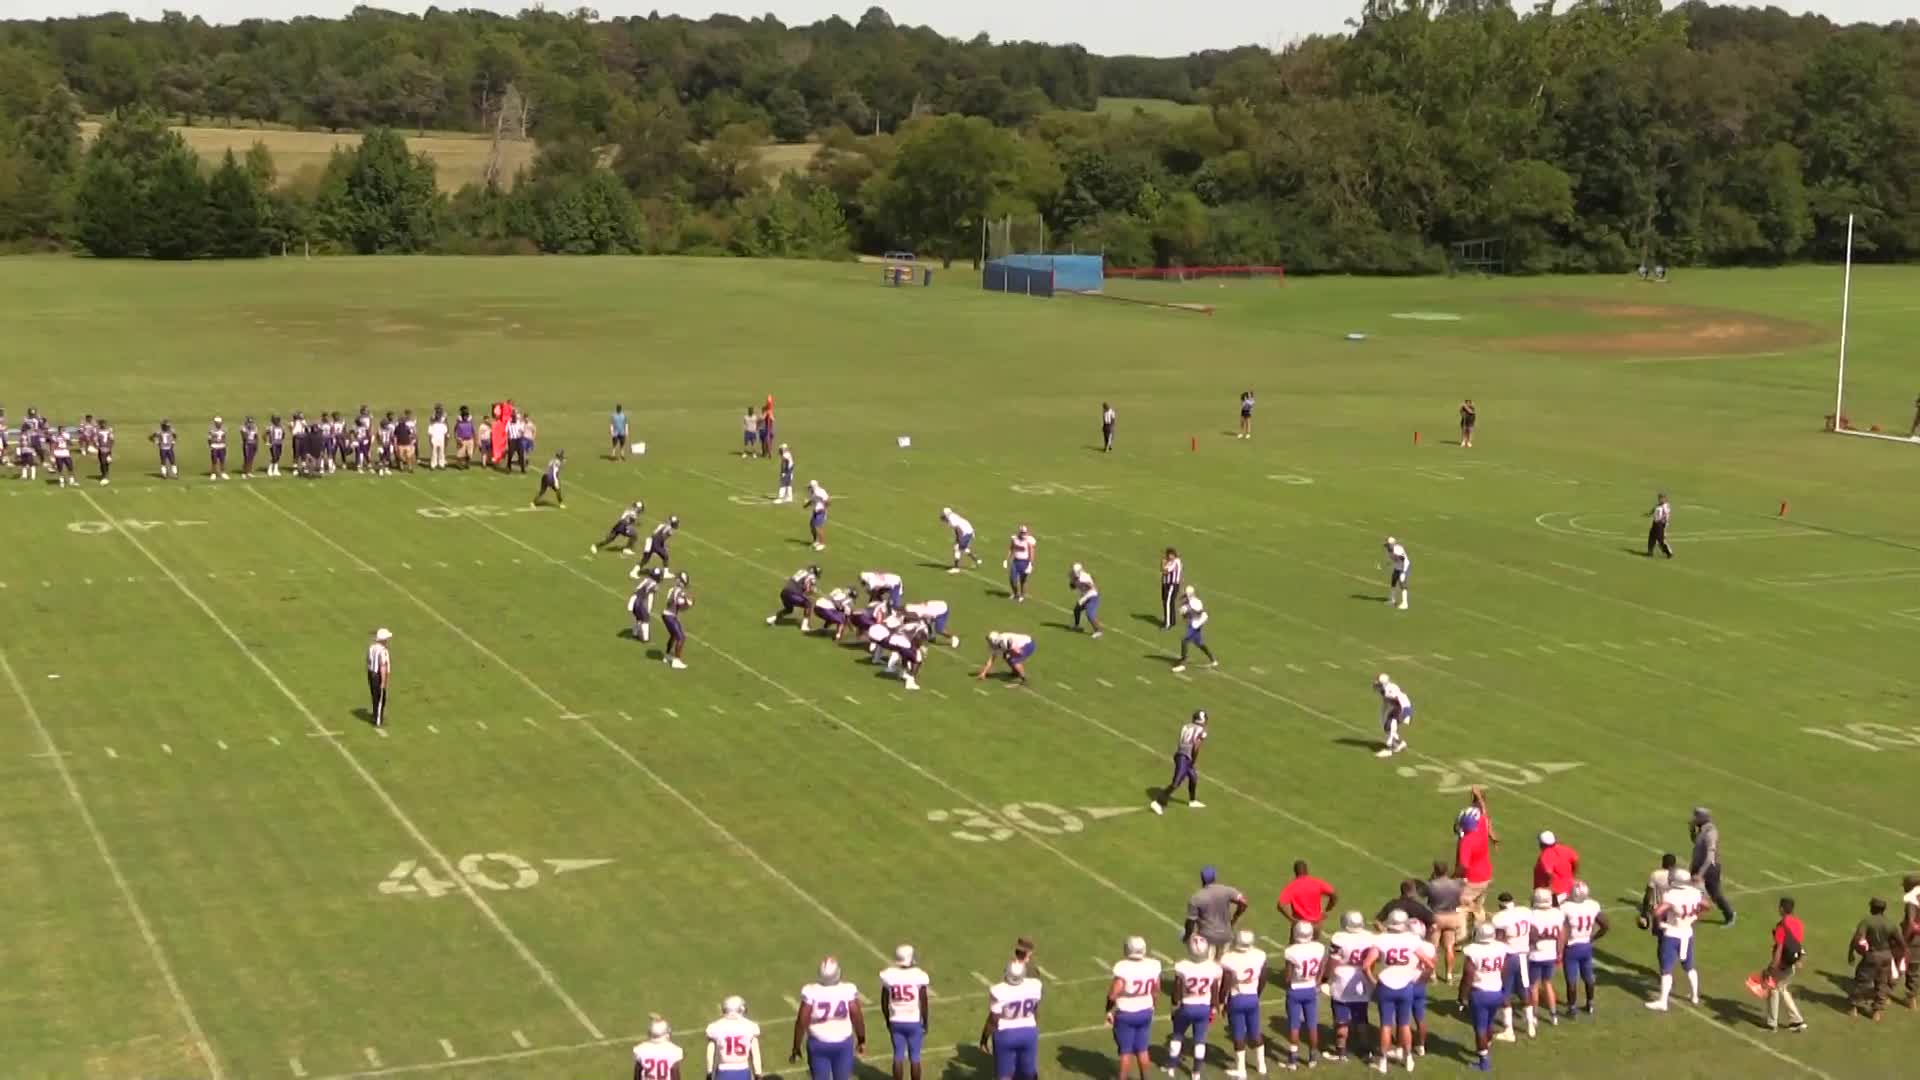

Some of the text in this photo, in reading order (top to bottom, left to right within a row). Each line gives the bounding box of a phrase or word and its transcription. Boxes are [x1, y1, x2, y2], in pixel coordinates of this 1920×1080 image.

[1396, 758, 1543, 793] 20
[927, 801, 1084, 842] 30
[377, 853, 540, 898] 40
[1577, 915, 1592, 932] 11
[1386, 948, 1410, 966] 65
[1302, 958, 1320, 978] 12
[891, 983, 915, 1002] 85
[1186, 977, 1210, 995] 22
[816, 1000, 849, 1022] 74
[724, 1035, 747, 1056] 15
[643, 1058, 670, 1080] 20
